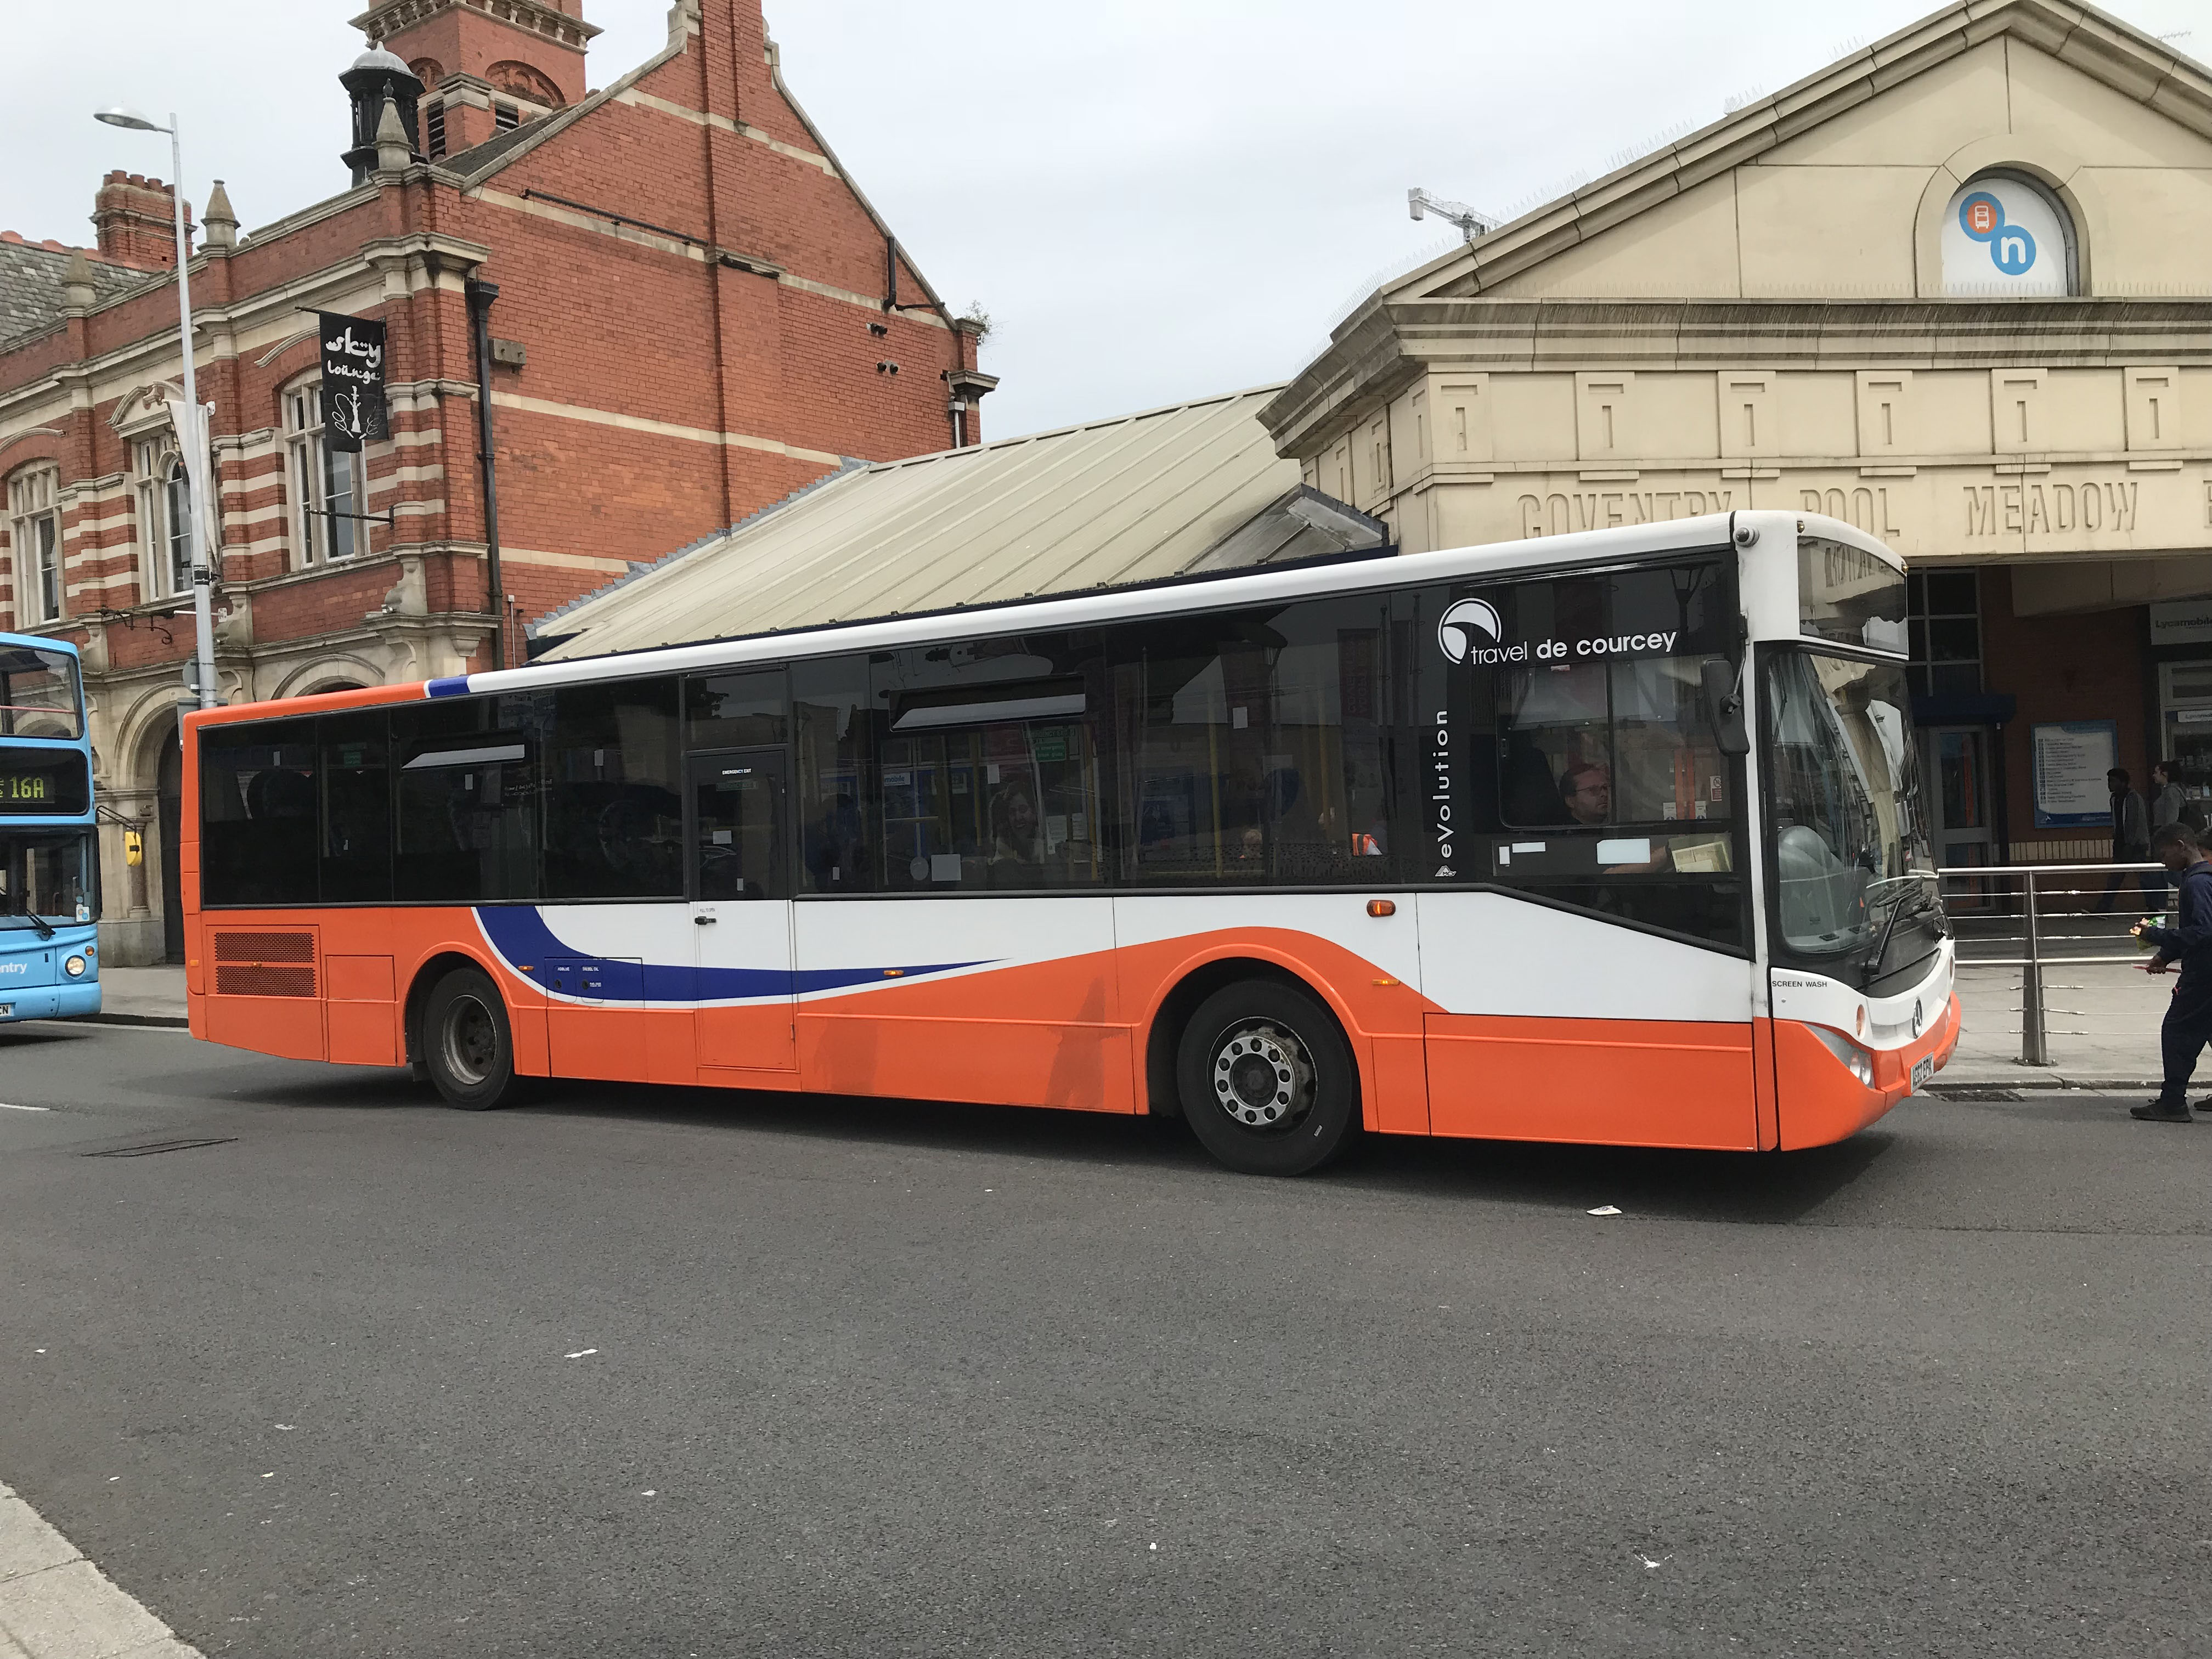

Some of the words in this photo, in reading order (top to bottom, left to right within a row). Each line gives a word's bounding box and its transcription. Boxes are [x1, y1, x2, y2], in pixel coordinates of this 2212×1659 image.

[2001, 236, 2026, 264] n
[325, 326, 381, 368] sky
[328, 359, 381, 384] lounge
[1799, 487, 1900, 537] POOL
[1963, 482, 2137, 535] MEADOW
[1471, 641, 1528, 665] travel
[1536, 639, 1567, 659] de
[1577, 631, 1677, 656] courcey
[9, 777, 44, 798] 16A
[0, 962, 27, 974] ntry
[0, 1006, 9, 1014] N
